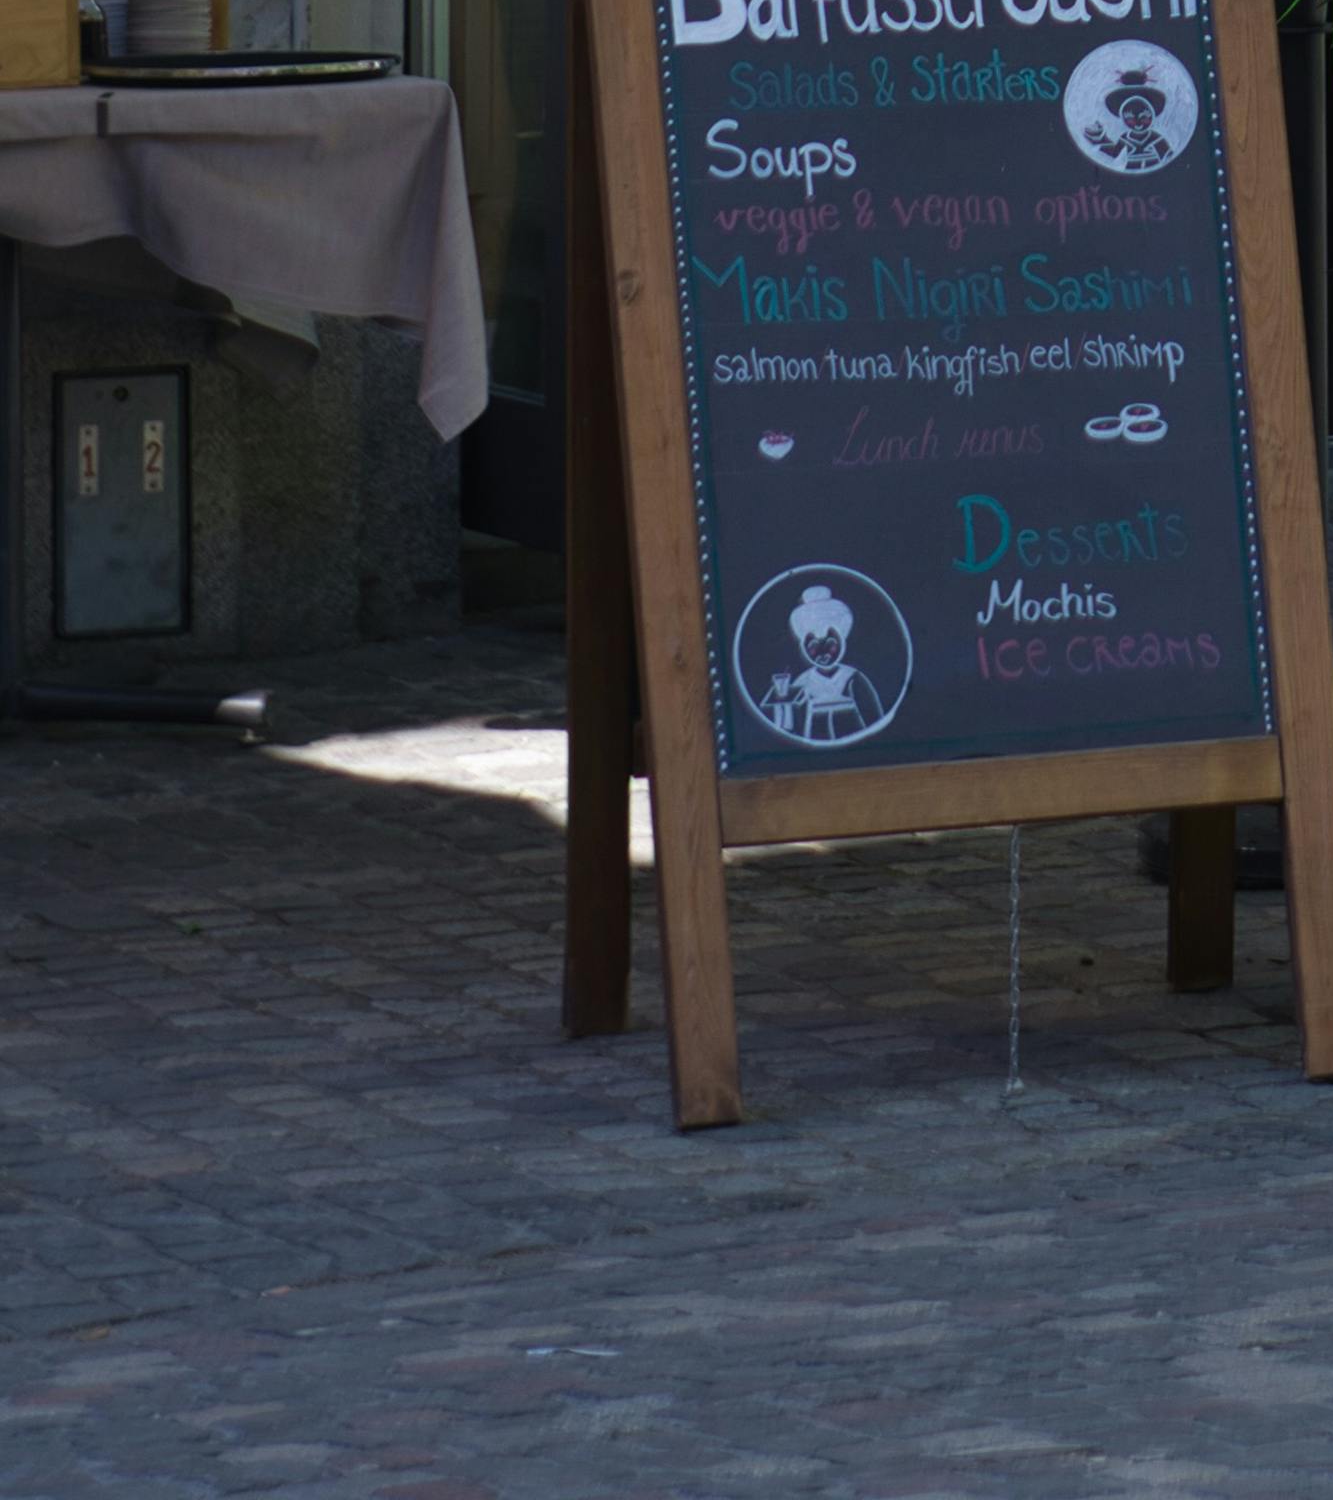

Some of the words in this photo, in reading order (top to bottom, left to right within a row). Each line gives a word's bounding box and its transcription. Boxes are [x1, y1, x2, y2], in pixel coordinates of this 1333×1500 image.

[728, 60, 859, 111] Salads
[870, 54, 897, 105] &
[706, 118, 858, 199] Soups
[713, 202, 841, 255] veggie
[851, 187, 876, 231] &
[890, 196, 1012, 251] vegan
[1034, 185, 1169, 243] options
[692, 254, 849, 325] Makis
[1019, 252, 1193, 314] Sashimi
[82, 444, 96, 477] 1
[146, 441, 162, 474] 2
[832, 404, 941, 468] Lunch
[952, 493, 1189, 574] Desserts
[976, 577, 1118, 627] Mochis
